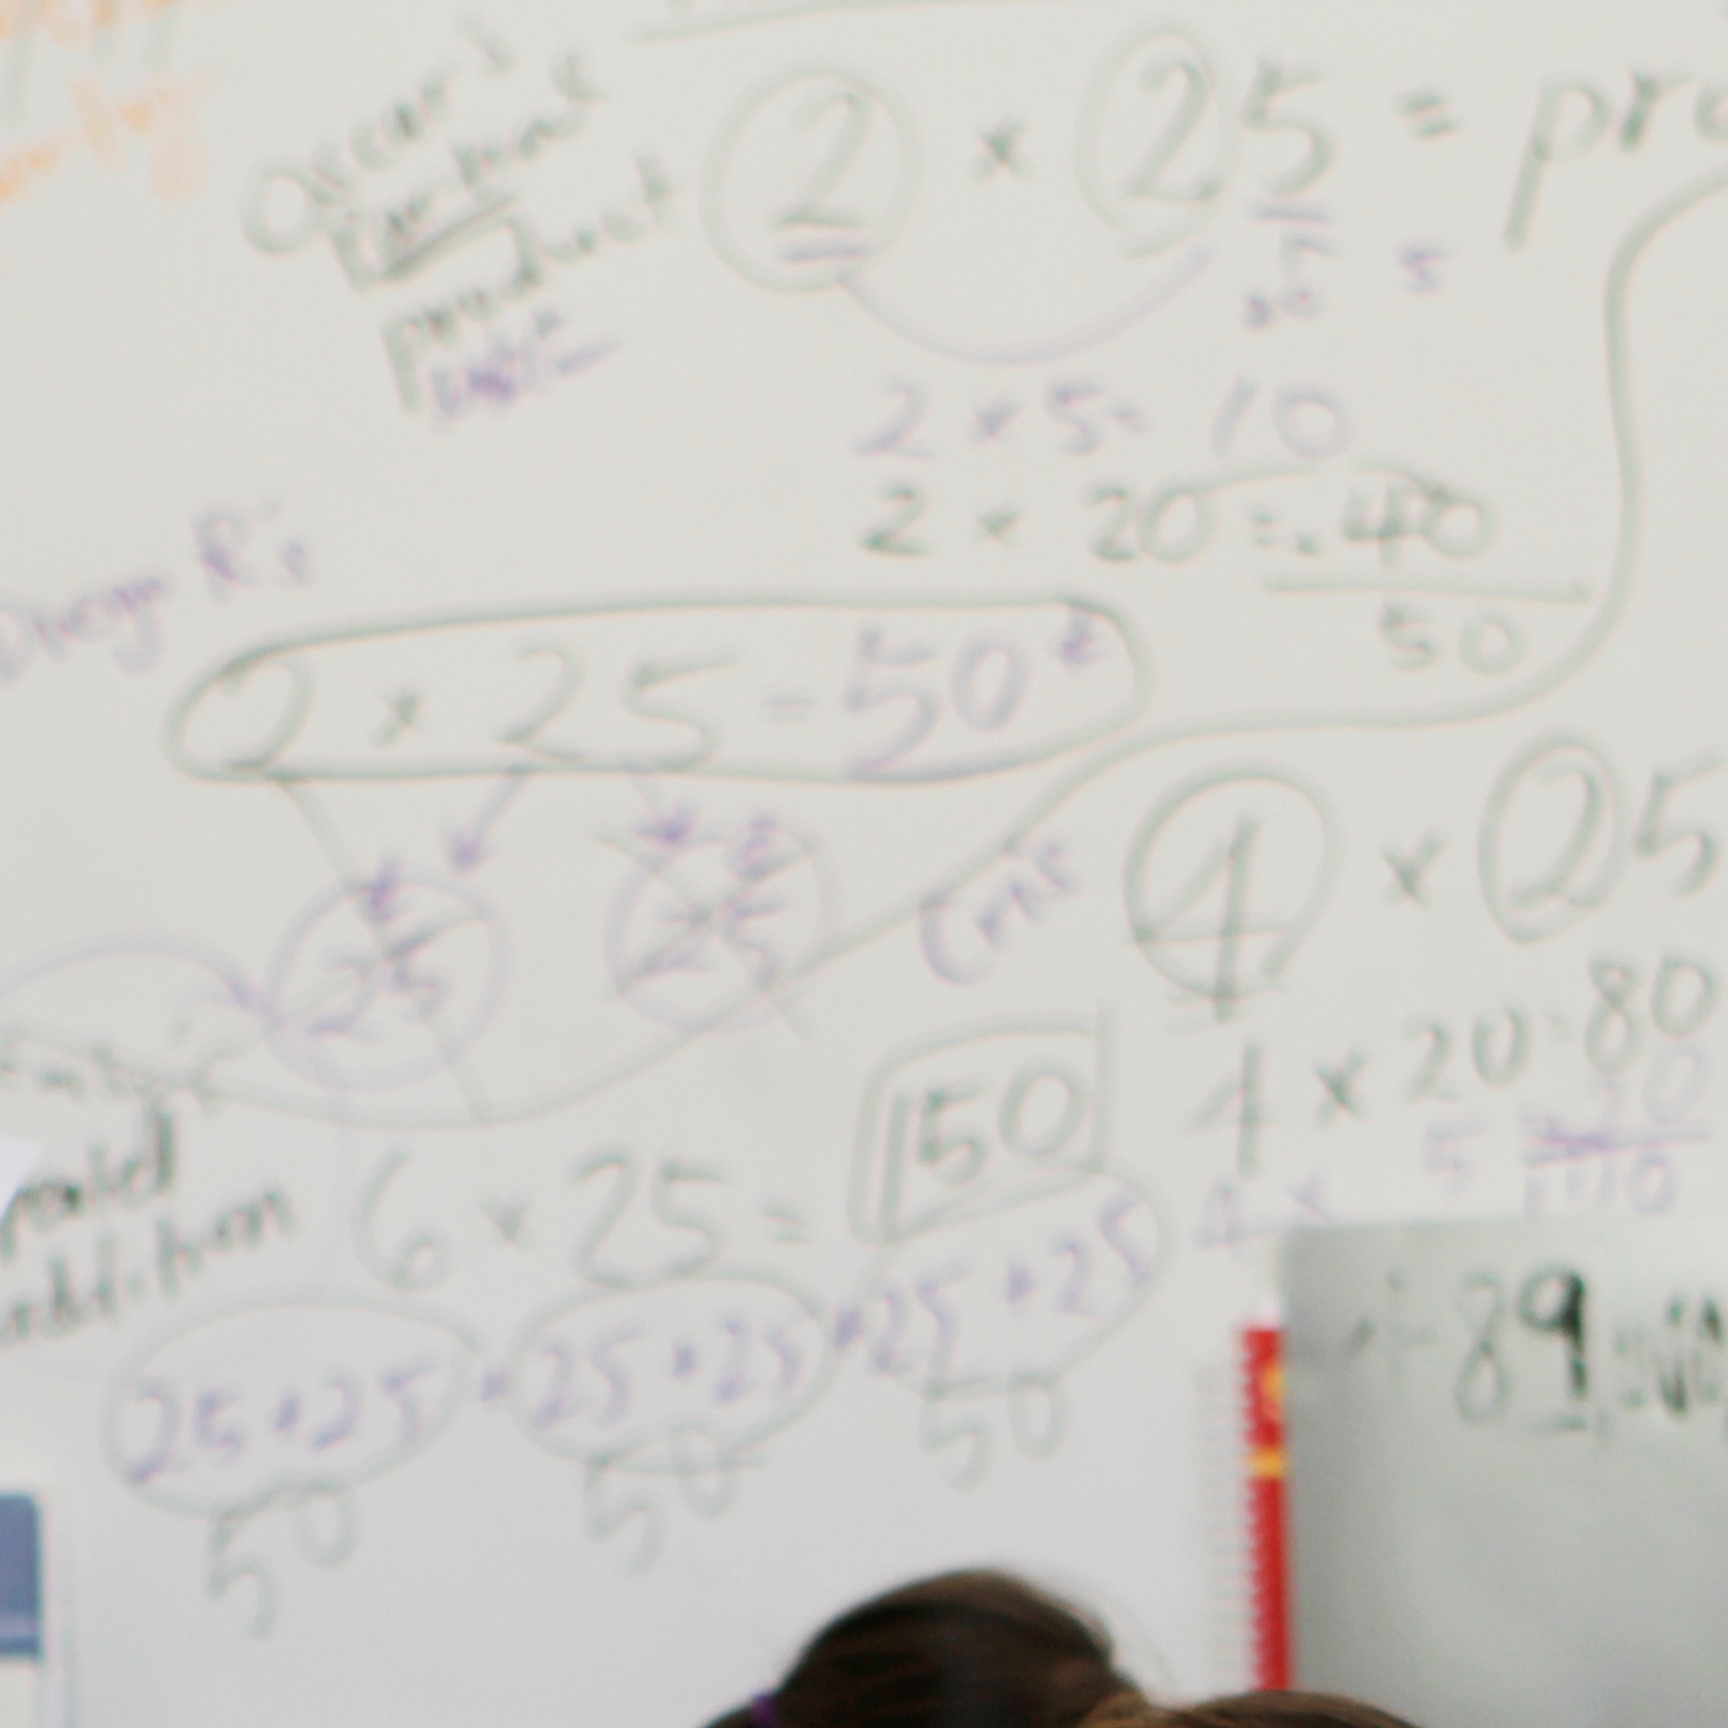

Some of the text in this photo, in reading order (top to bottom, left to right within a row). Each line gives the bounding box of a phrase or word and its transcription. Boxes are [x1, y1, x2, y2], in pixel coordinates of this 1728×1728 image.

[1137, 55, 1337, 202] 25
[1084, 480, 1220, 566] 20
[494, 640, 742, 770] 25
[1378, 600, 1530, 680] 50
[1402, 1003, 1532, 1104] 20
[1585, 948, 1722, 1076] 80
[570, 1145, 728, 1293] 25
